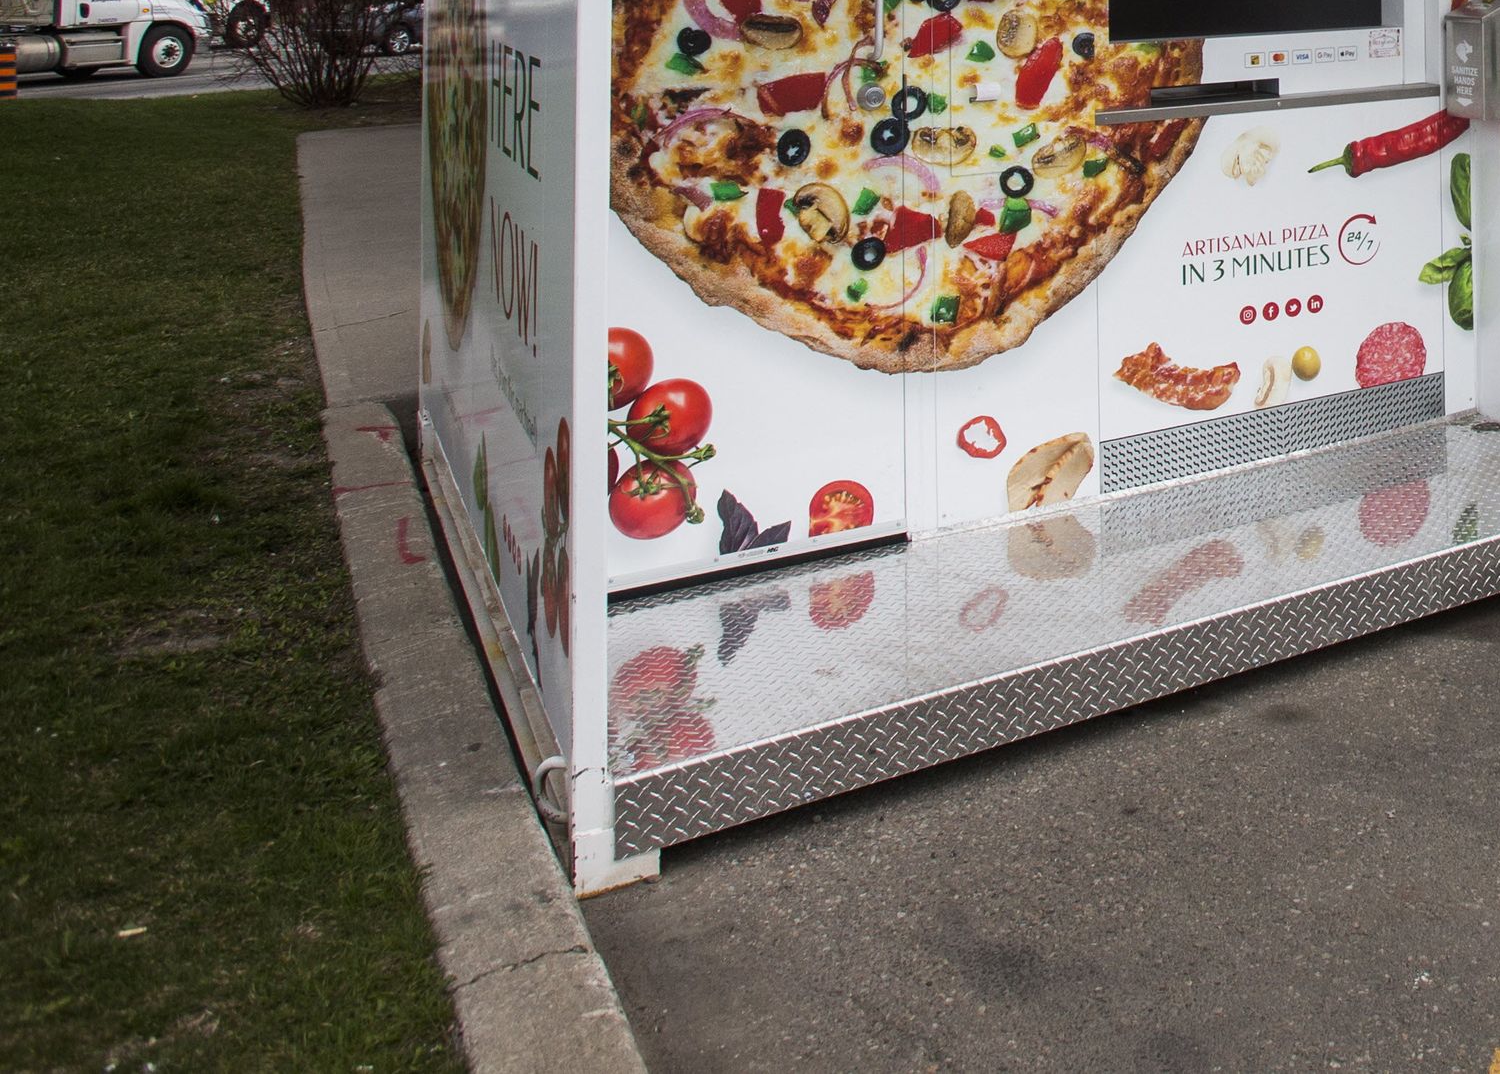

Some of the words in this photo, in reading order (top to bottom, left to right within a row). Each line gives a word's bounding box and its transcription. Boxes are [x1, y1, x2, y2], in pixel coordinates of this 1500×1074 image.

[1451, 66, 1478, 77] SANITIZE
[1454, 76, 1475, 86] HANDS
[1456, 86, 1473, 95] HERE
[491, 38, 542, 181] HERE.
[1182, 230, 1277, 258] ARTISANAL
[1282, 224, 1329, 244] PIZZA
[1347, 230, 1374, 252] 24/7
[490, 195, 538, 357] NOW!
[1182, 261, 1205, 285] IN
[1213, 259, 1225, 282] 3
[1232, 244, 1330, 278] MINUTES
